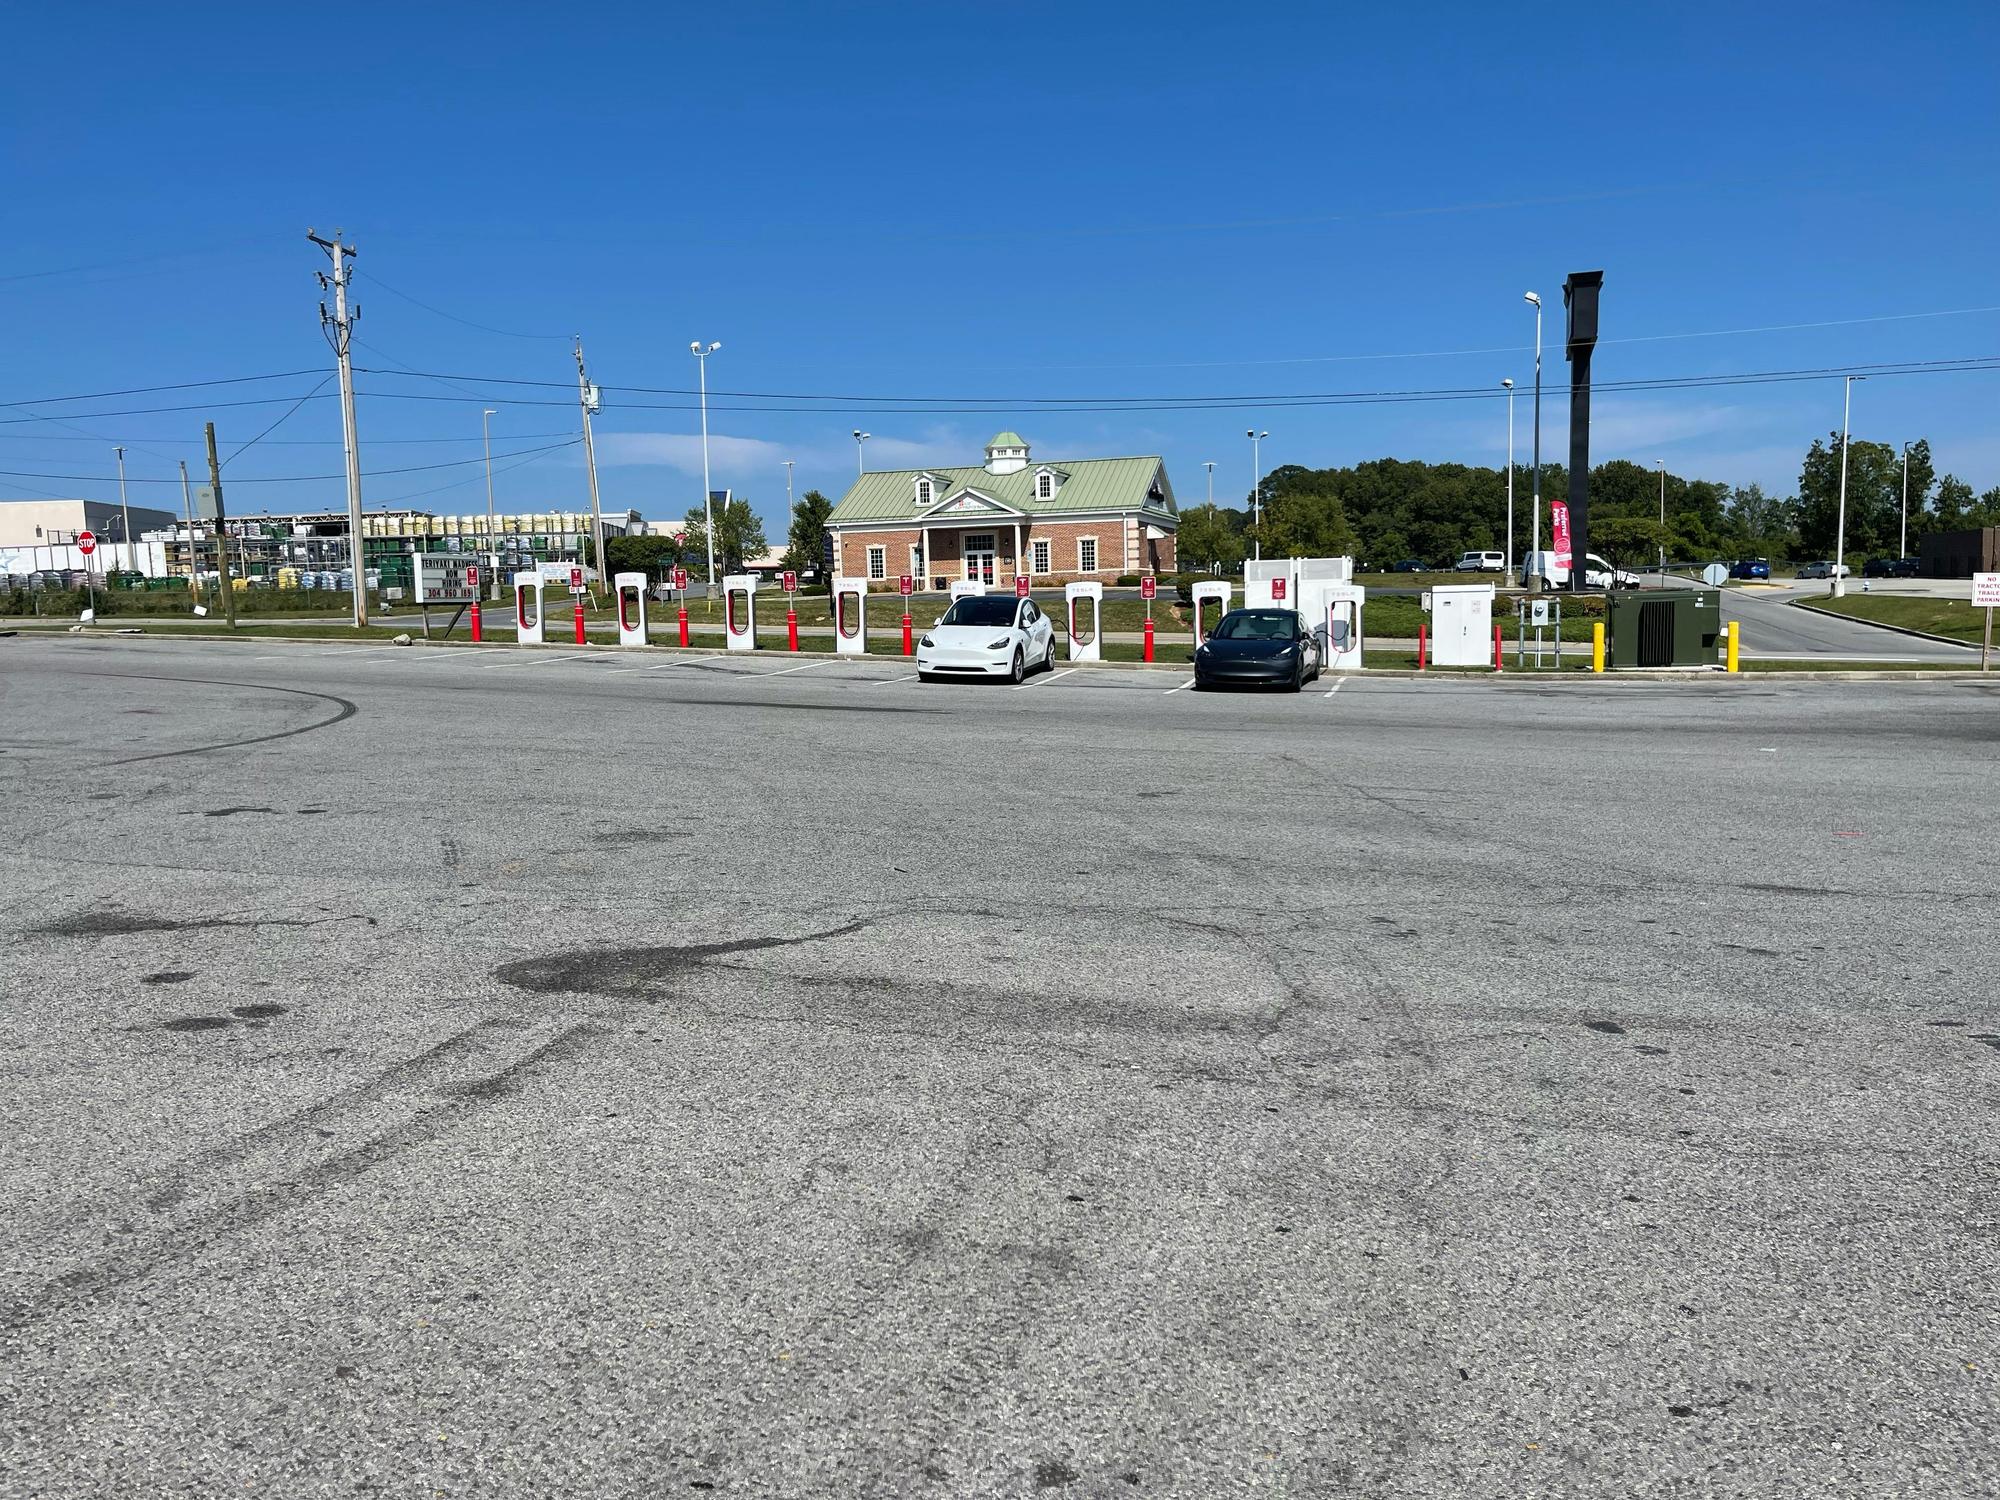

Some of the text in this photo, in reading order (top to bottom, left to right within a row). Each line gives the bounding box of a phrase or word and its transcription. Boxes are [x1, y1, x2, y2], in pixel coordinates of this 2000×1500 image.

[79, 538, 95, 549] STOP
[422, 559, 450, 568] TERIYAKI
[445, 569, 458, 578] NOW
[442, 579, 462, 588] HIRING
